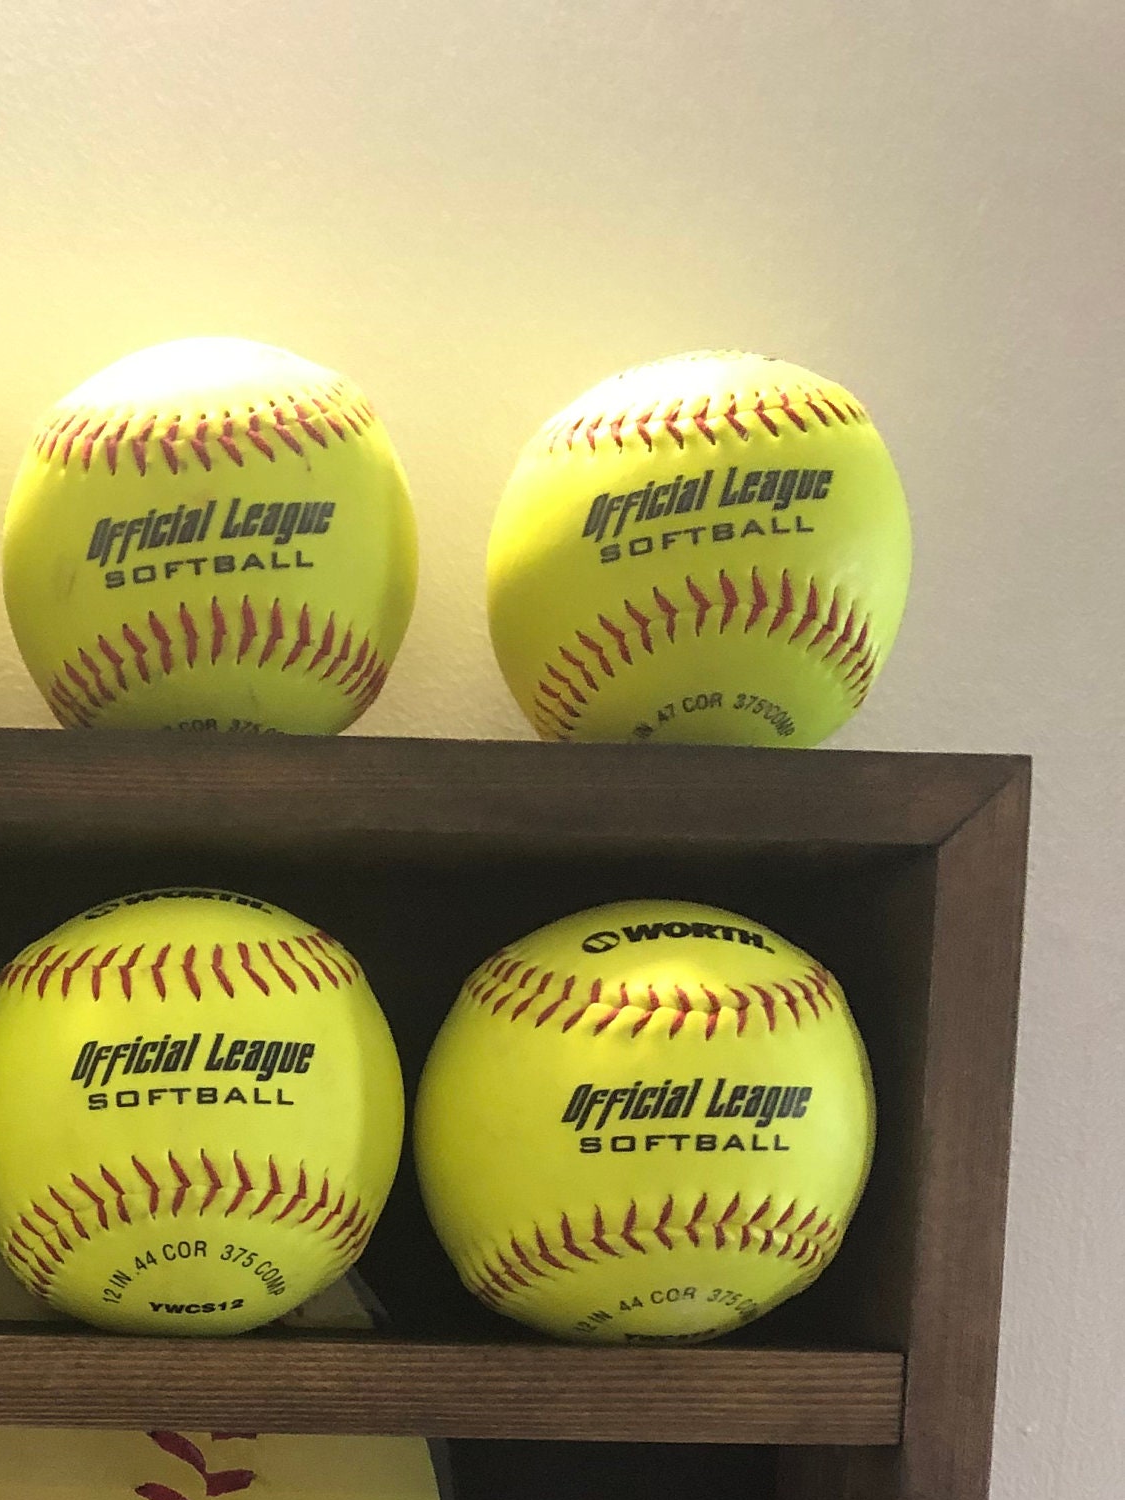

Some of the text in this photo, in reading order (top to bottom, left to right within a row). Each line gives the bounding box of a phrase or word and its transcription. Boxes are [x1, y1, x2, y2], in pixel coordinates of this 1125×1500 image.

[582, 467, 834, 543] Official League
[85, 498, 336, 568] Official League
[600, 516, 814, 564] SOFTBALL
[104, 550, 314, 589] SOFTBALL
[682, 692, 723, 713] COR
[733, 693, 766, 714] 375
[763, 705, 796, 737] COMP
[71, 1033, 315, 1088] Official League
[88, 1087, 294, 1110] SOFTBALL
[561, 1078, 812, 1131] Official League
[579, 1133, 791, 1154] SOFTBALL
[162, 1240, 207, 1261] COR
[220, 1244, 259, 1268] 375
[103, 1288, 122, 1304] 12
[109, 1270, 132, 1289] IN
[254, 1261, 286, 1296] COMP
[149, 1299, 245, 1314] YWCS12
[587, 1309, 613, 1326] IN
[650, 1286, 697, 1304] COR
[707, 1288, 743, 1306] 375
